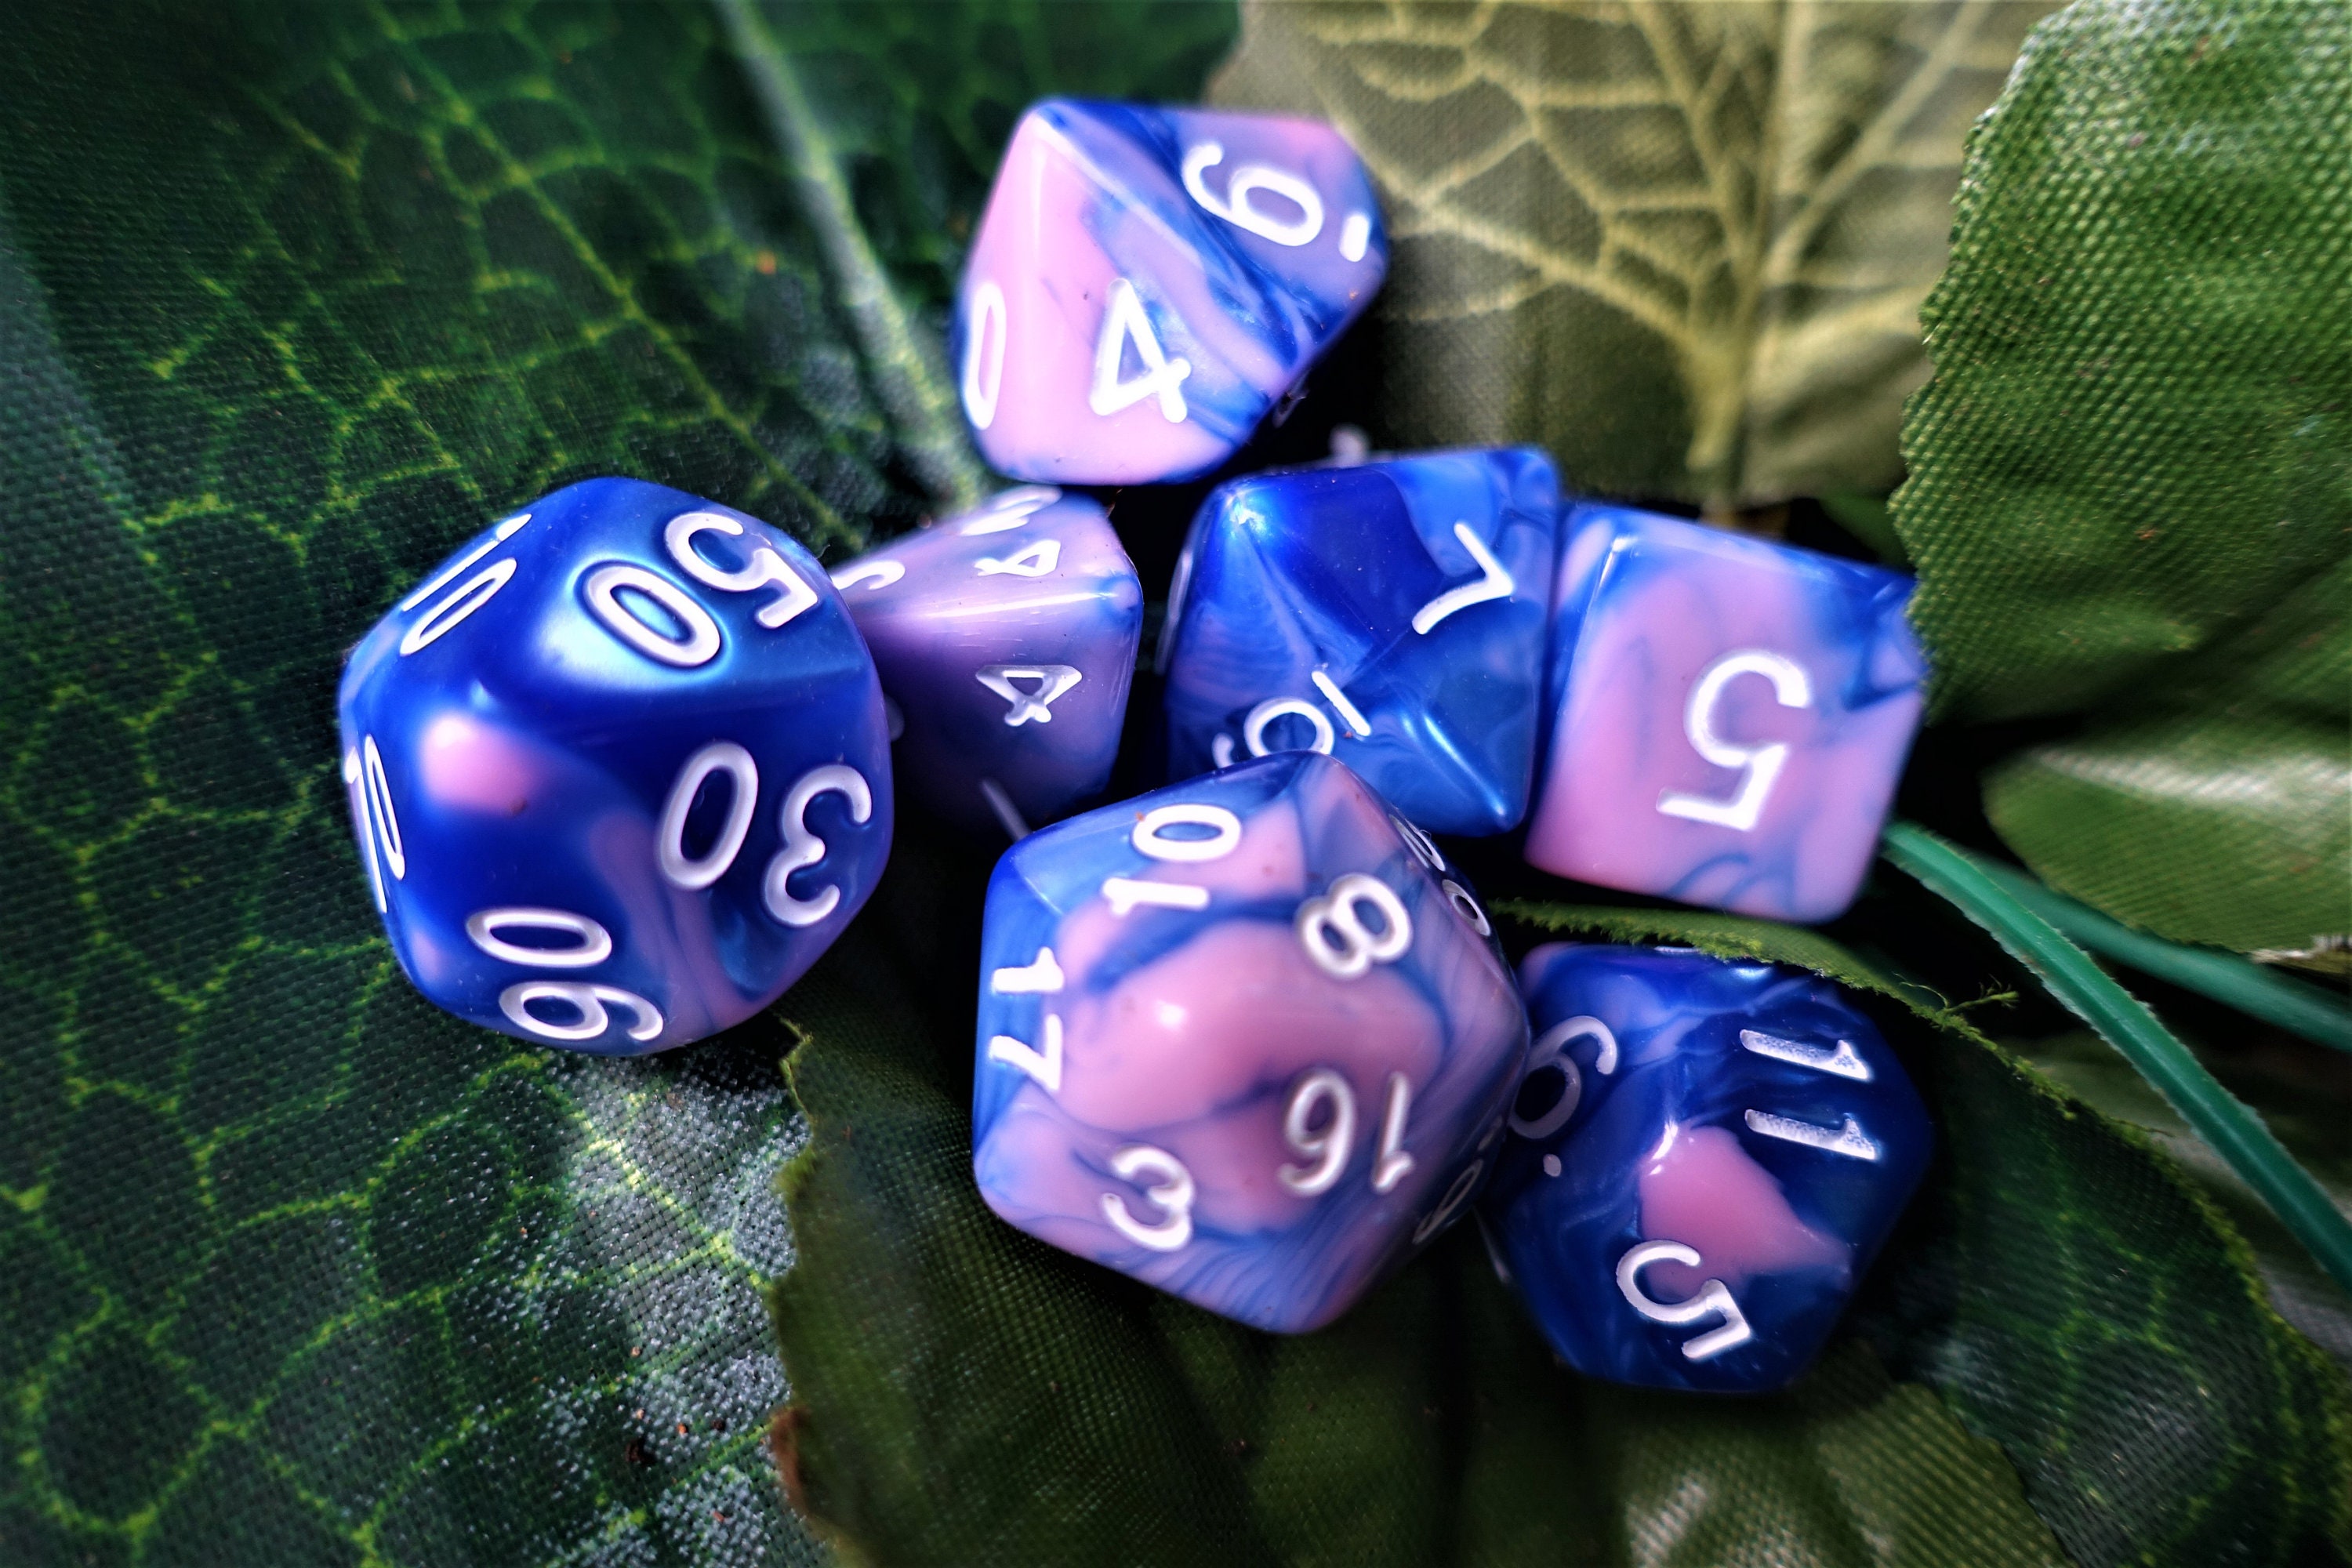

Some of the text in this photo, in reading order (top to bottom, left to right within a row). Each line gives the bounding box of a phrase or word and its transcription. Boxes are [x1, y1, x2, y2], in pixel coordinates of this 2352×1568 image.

[961, 281, 1007, 430] 0
[1090, 277, 1192, 424] 4
[399, 514, 532, 657] 10
[581, 510, 819, 670] 50
[973, 539, 1062, 579] 4
[1411, 521, 1515, 636] 7
[975, 664, 1083, 728] 4
[1655, 648, 1813, 833] 5
[658, 740, 873, 928] 30
[1101, 803, 1243, 916] 10
[464, 906, 666, 1041] 90
[1296, 872, 1413, 980] 8
[990, 946, 1065, 1094] 17
[1277, 1066, 1416, 1198] 16
[1738, 1029, 1880, 1160] 11
[1099, 1144, 1196, 1254] 3
[1615, 1238, 1753, 1361] 5
